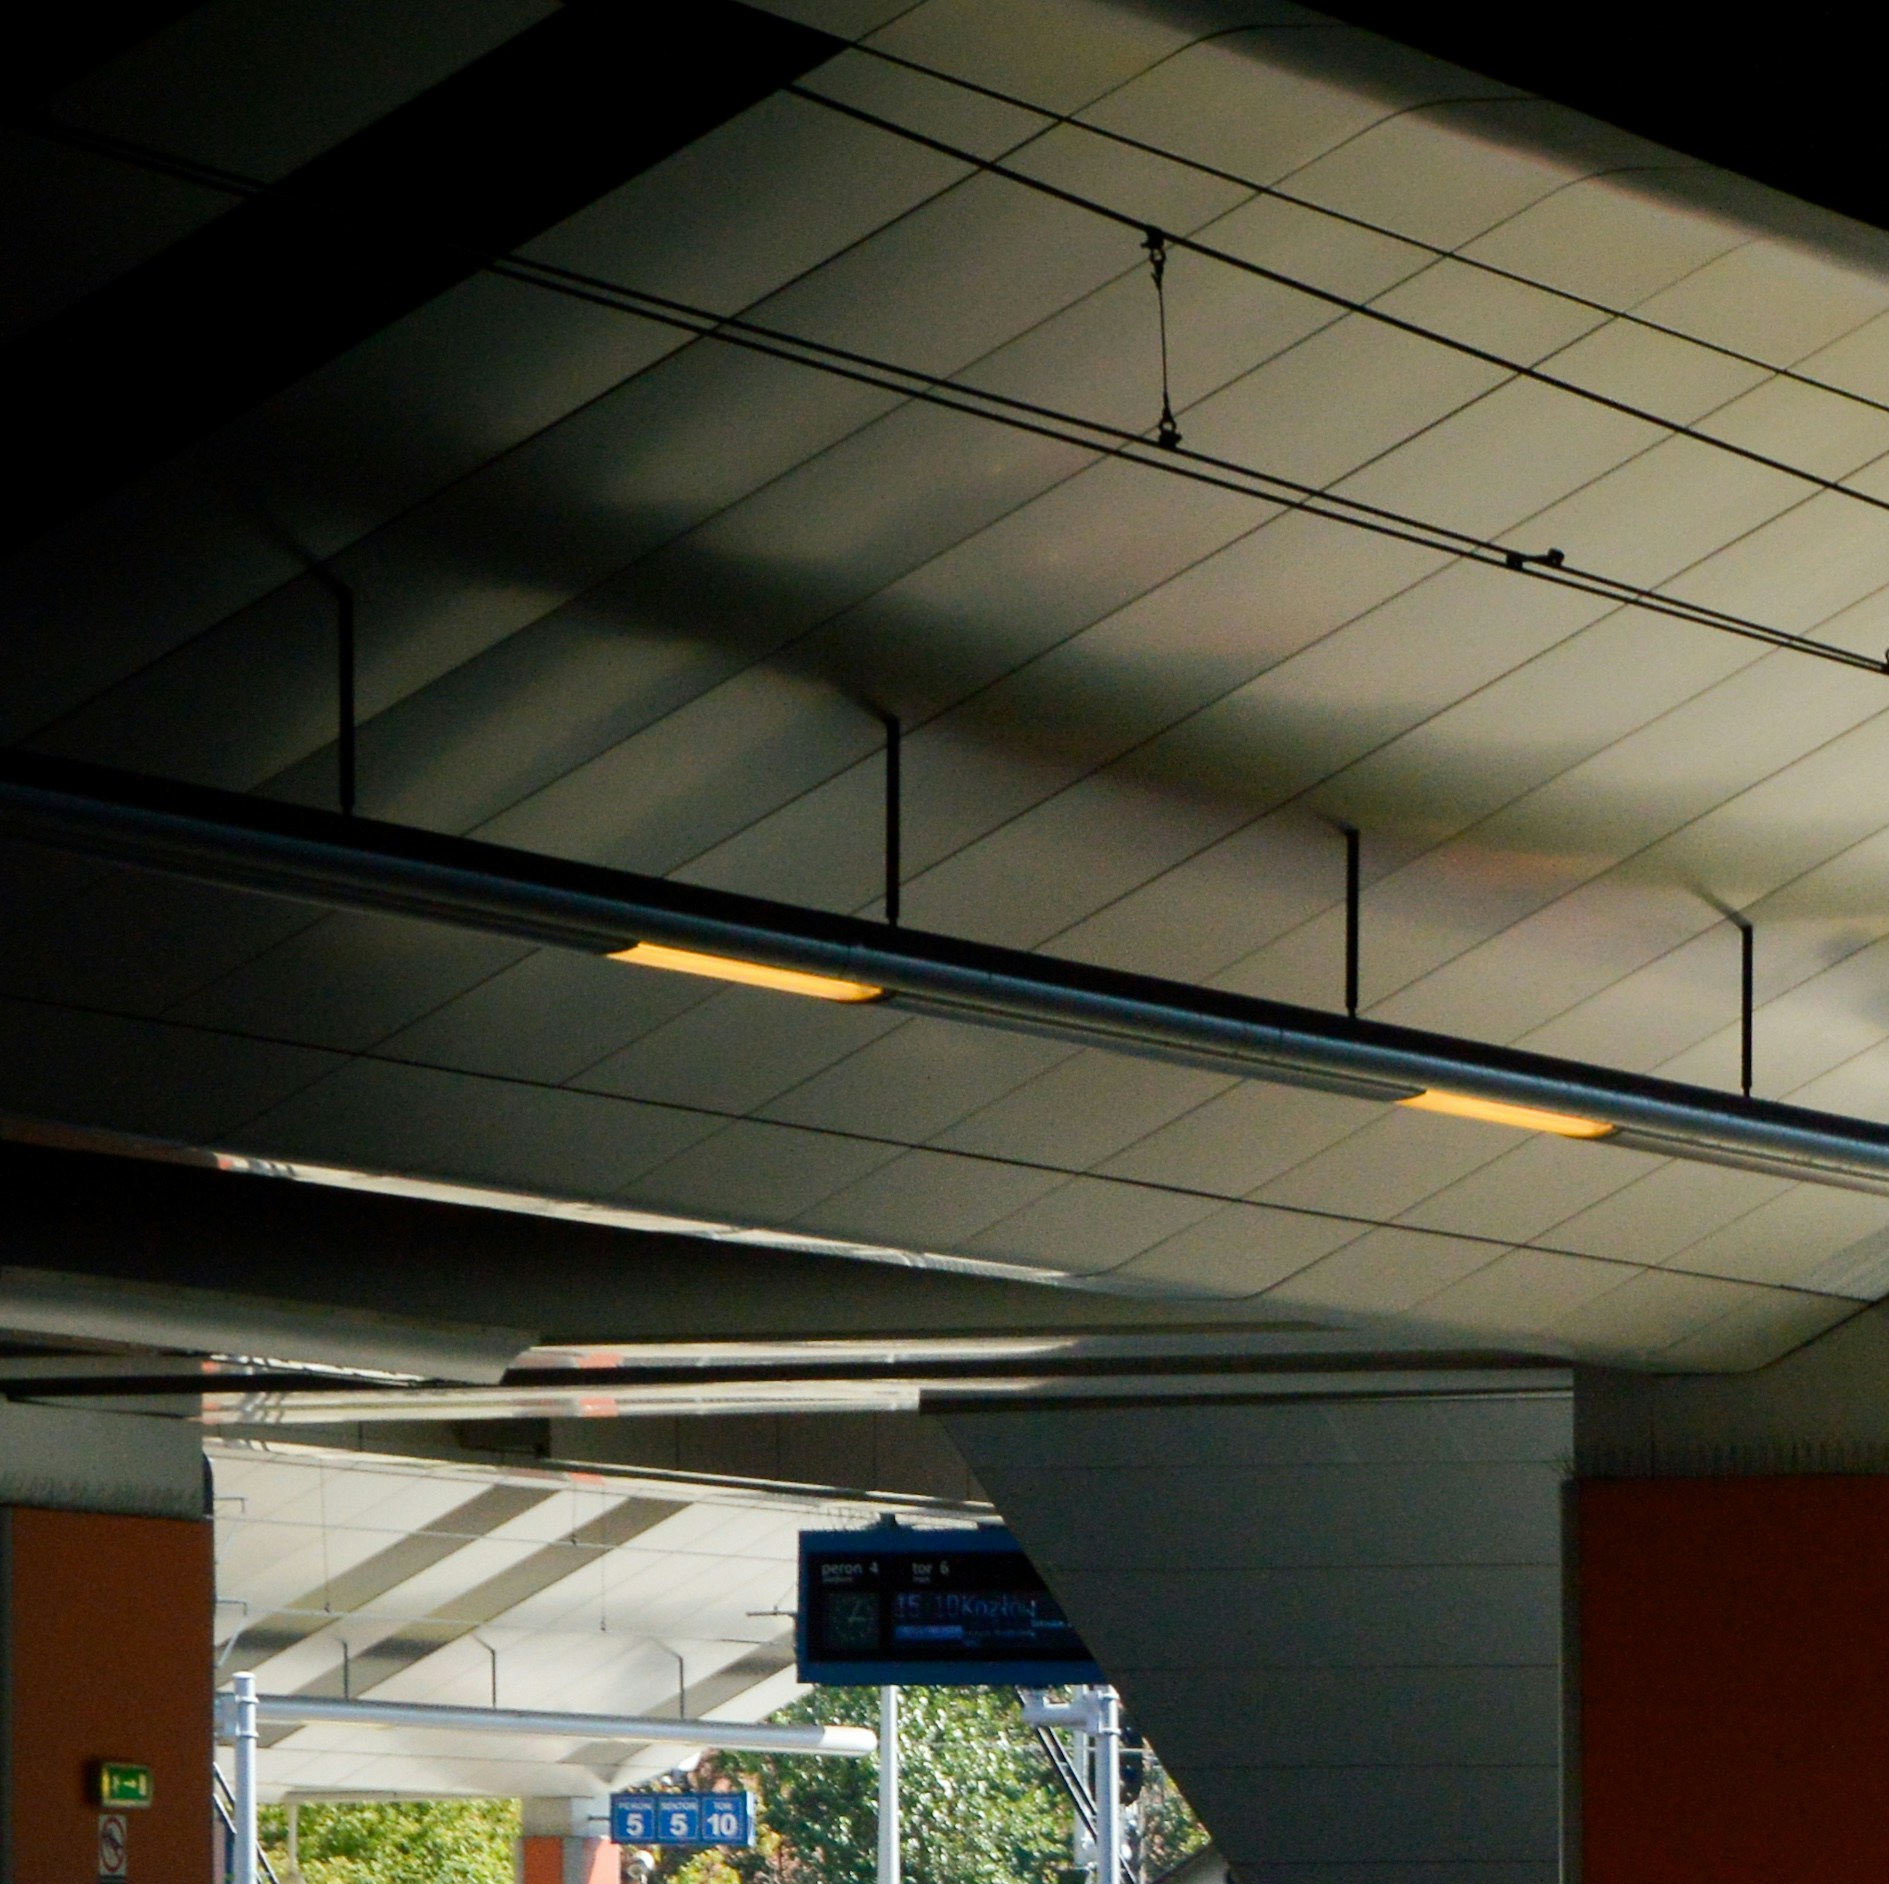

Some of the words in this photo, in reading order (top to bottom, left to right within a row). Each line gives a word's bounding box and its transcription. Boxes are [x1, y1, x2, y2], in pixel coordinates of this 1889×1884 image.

[820, 1563, 864, 1577] peron
[869, 1561, 879, 1575] 4
[912, 1561, 933, 1575] tor
[939, 1561, 950, 1575] 6
[626, 1812, 644, 1836] 5
[669, 1812, 688, 1836] 5
[707, 1812, 738, 1836] 10
